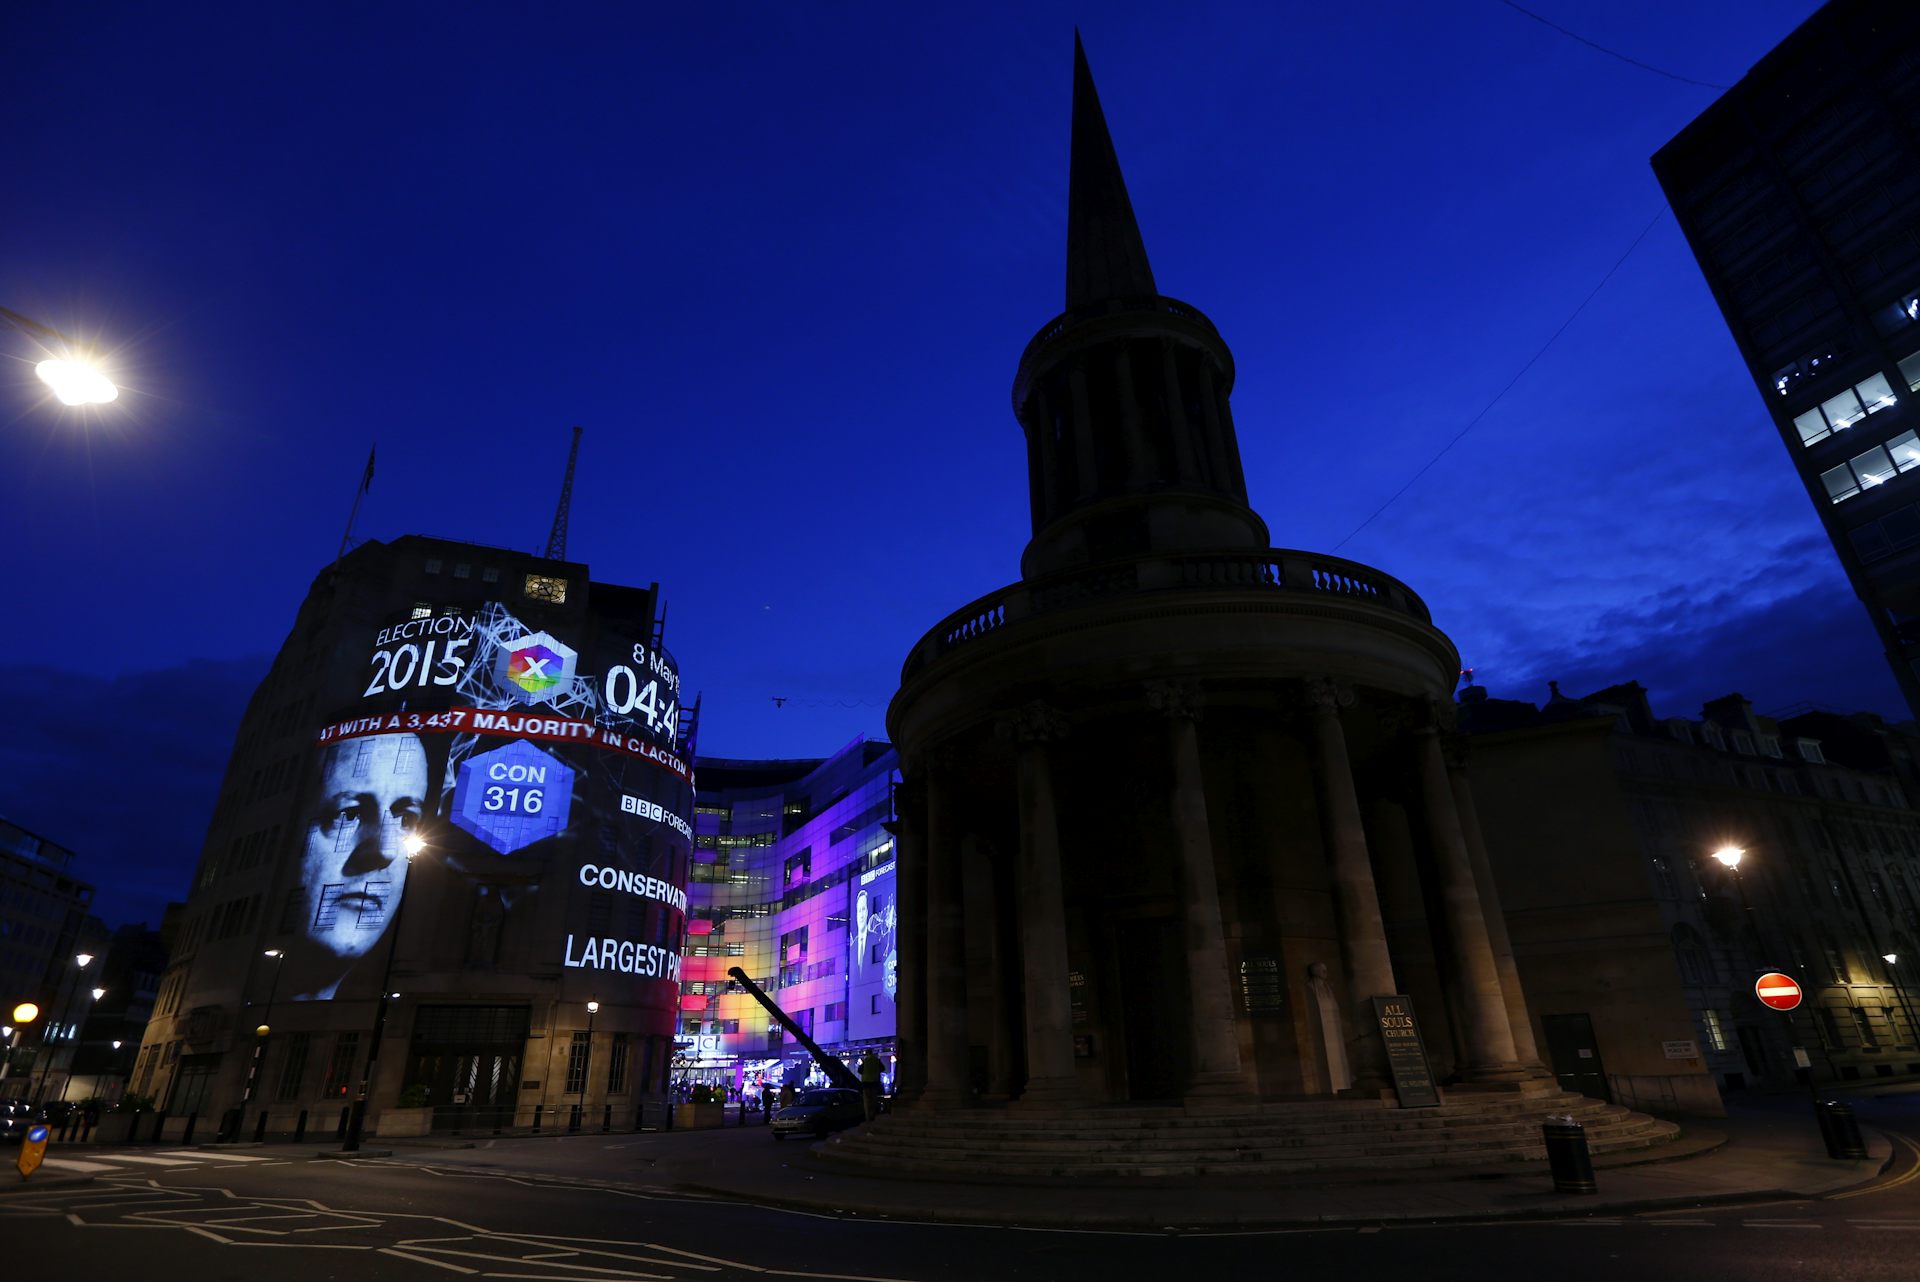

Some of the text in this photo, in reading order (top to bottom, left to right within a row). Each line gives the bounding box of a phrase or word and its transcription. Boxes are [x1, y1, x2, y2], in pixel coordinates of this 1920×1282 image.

[376, 616, 476, 647] ELECTION
[363, 639, 470, 698] 2015
[632, 643, 645, 664] 8
[650, 650, 675, 690] May
[339, 716, 382, 736] WITH
[386, 715, 401, 729] A
[407, 711, 467, 730] 3,437
[473, 712, 597, 738] MAJORITY
[602, 730, 622, 747] IN
[627, 738, 687, 776] CLACTON
[489, 762, 547, 784] CON
[483, 786, 544, 814] 316
[621, 794, 663, 823] BBC
[564, 934, 667, 978] LARGEST
[1381, 1016, 1413, 1028] SOULS
[1385, 1005, 1405, 1016] ALL
